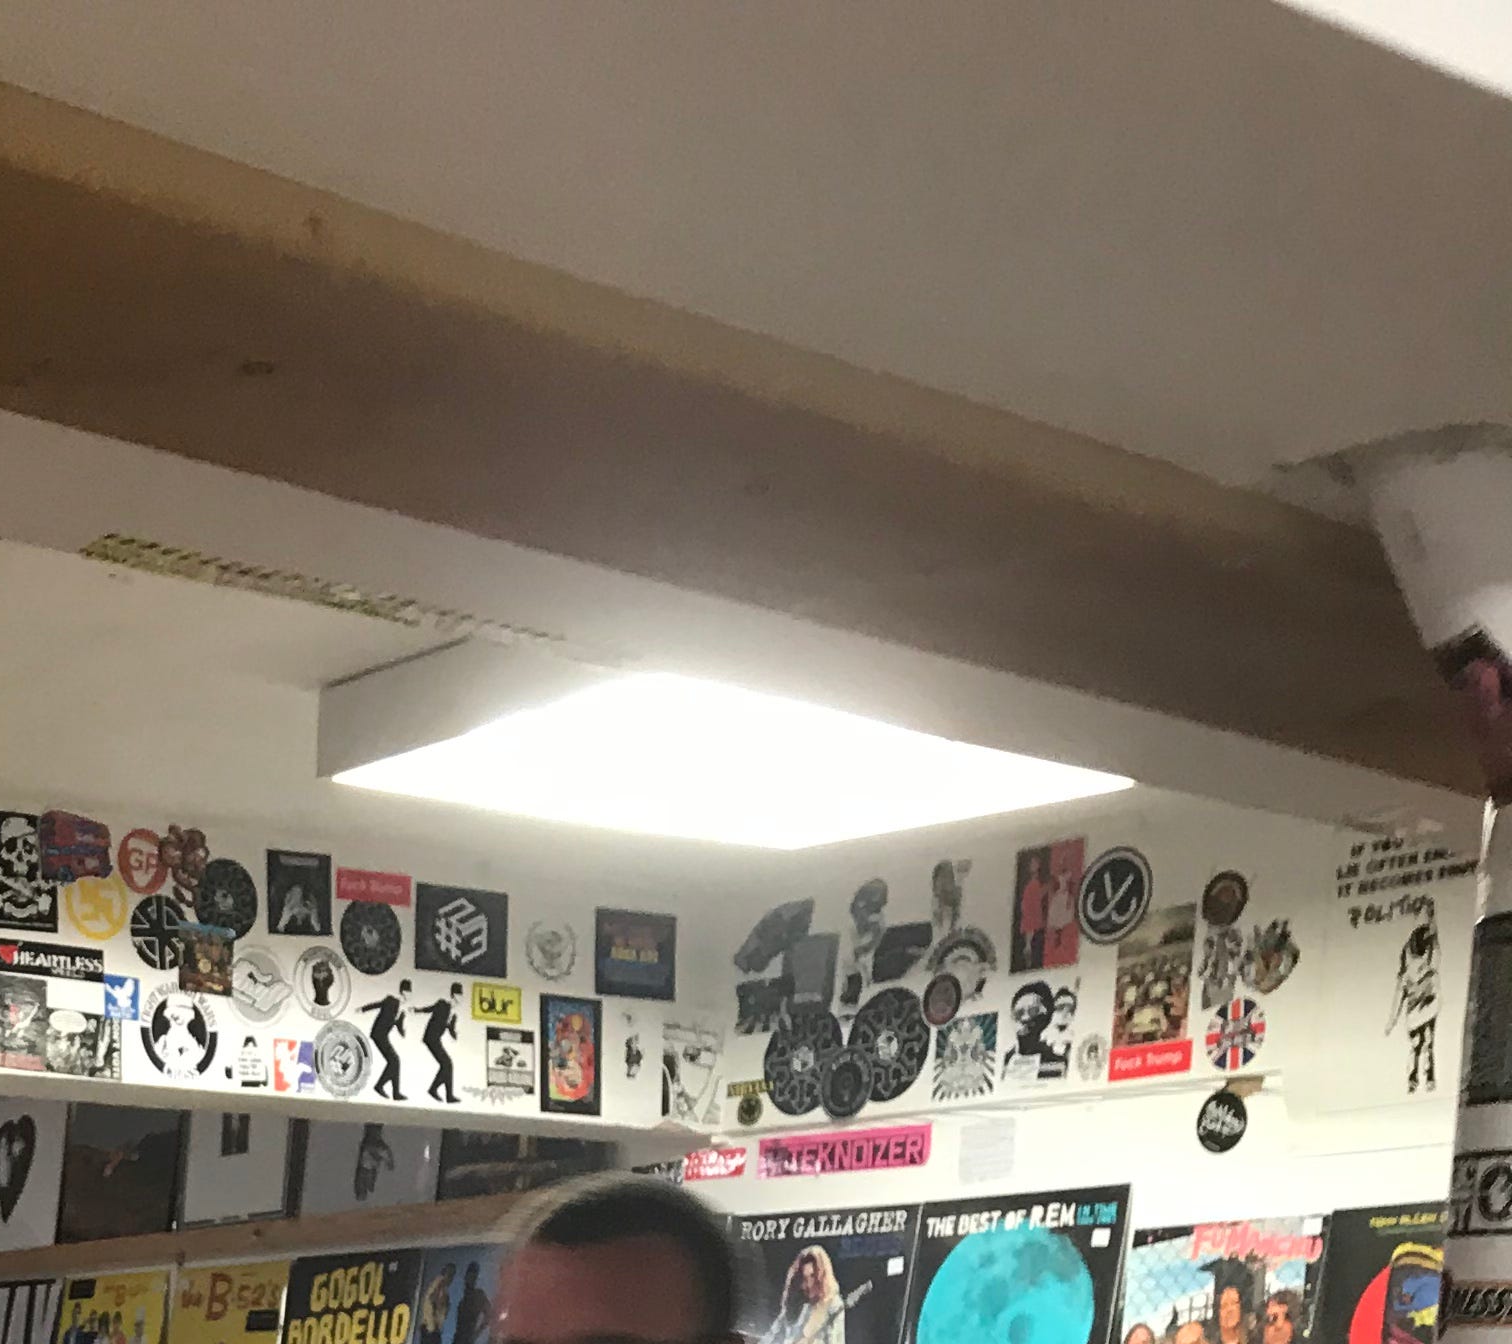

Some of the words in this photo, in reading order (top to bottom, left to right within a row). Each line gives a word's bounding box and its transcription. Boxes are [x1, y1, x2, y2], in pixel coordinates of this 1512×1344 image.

[12, 951, 104, 974] HEARTLESS
[477, 990, 513, 1016] blur
[1144, 1049, 1184, 1070] Trump
[790, 1133, 926, 1173] TEKNOIZER
[740, 1217, 790, 1242] RORY
[792, 1209, 908, 1238] GALLAGHER
[926, 1215, 956, 1238] THE
[957, 1211, 1002, 1236] BEST
[1004, 1208, 1025, 1230] OF
[310, 1261, 387, 1314] GOGOL
